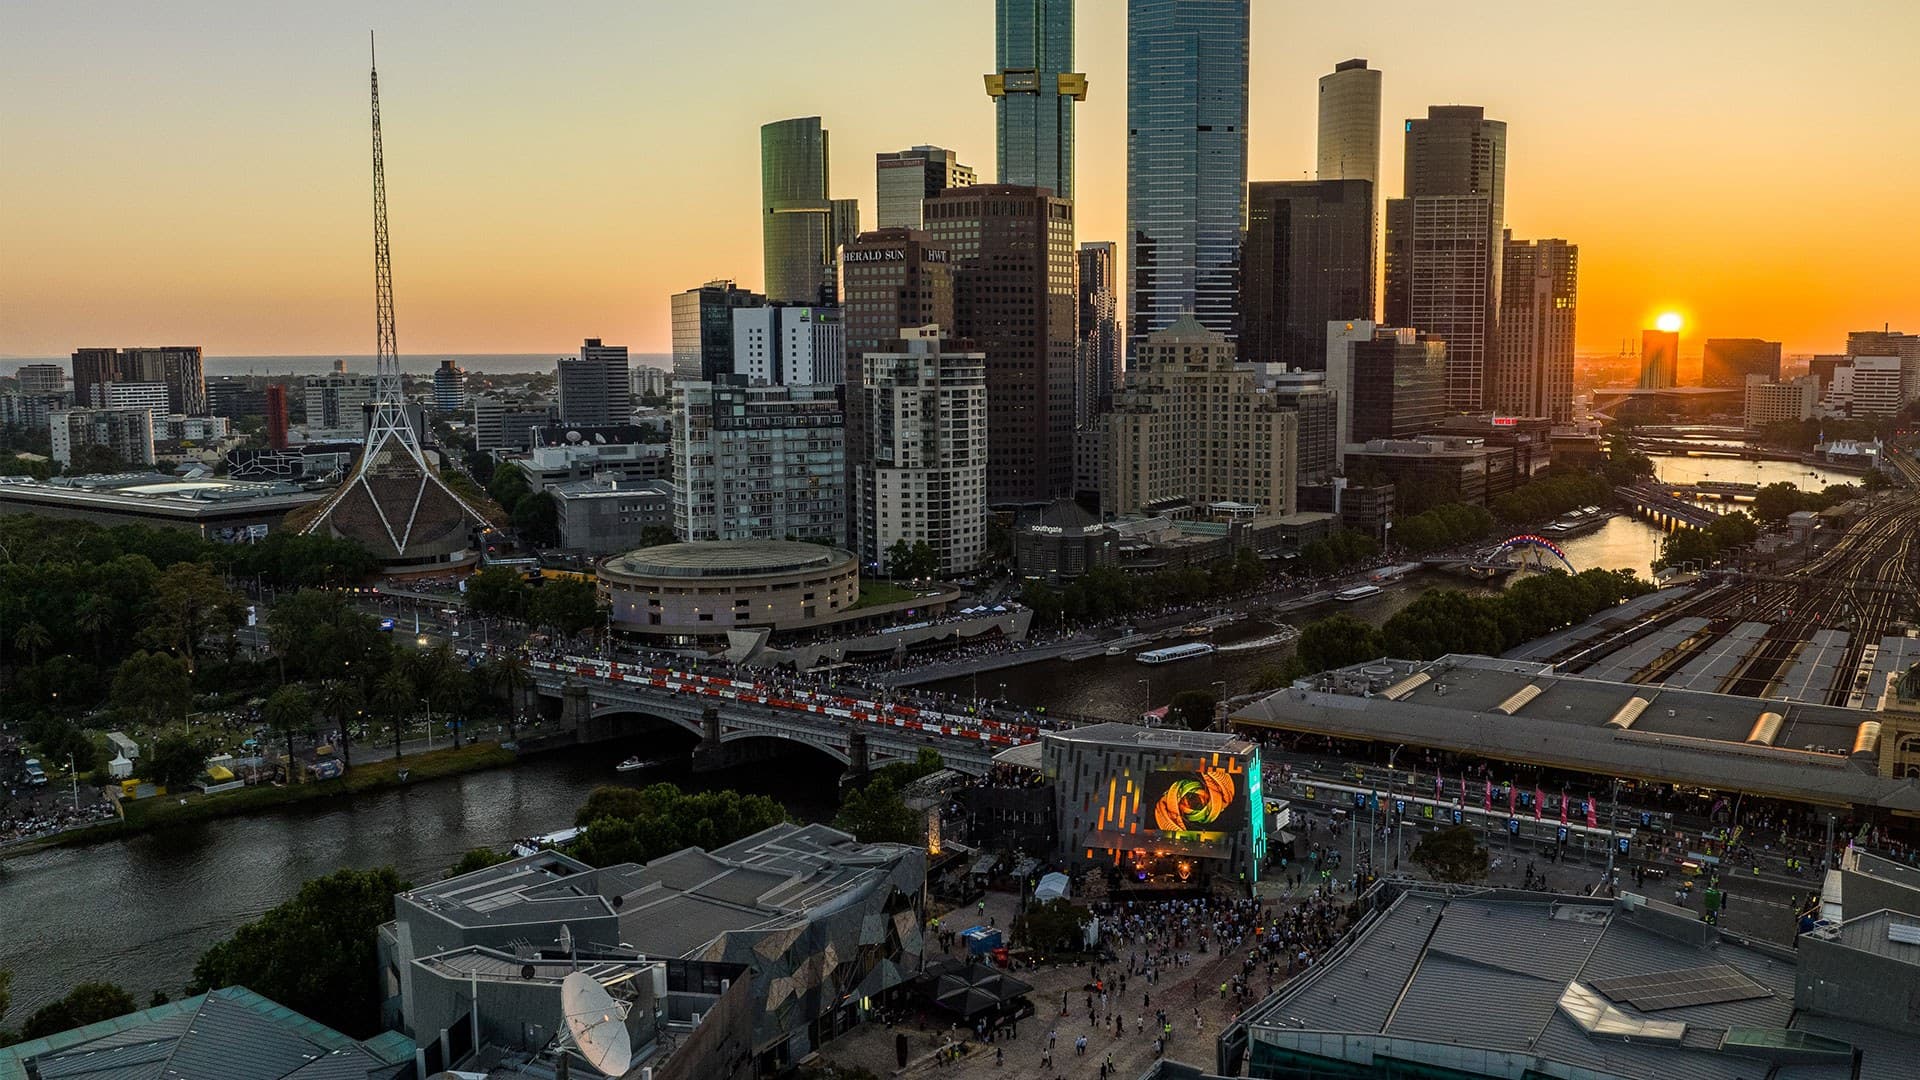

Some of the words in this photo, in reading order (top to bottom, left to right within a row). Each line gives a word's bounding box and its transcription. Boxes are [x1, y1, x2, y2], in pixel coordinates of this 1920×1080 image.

[843, 251, 881, 262] HERALD
[885, 249, 904, 260] SUN
[928, 250, 947, 262] HWT
[1032, 525, 1063, 535] southgate
